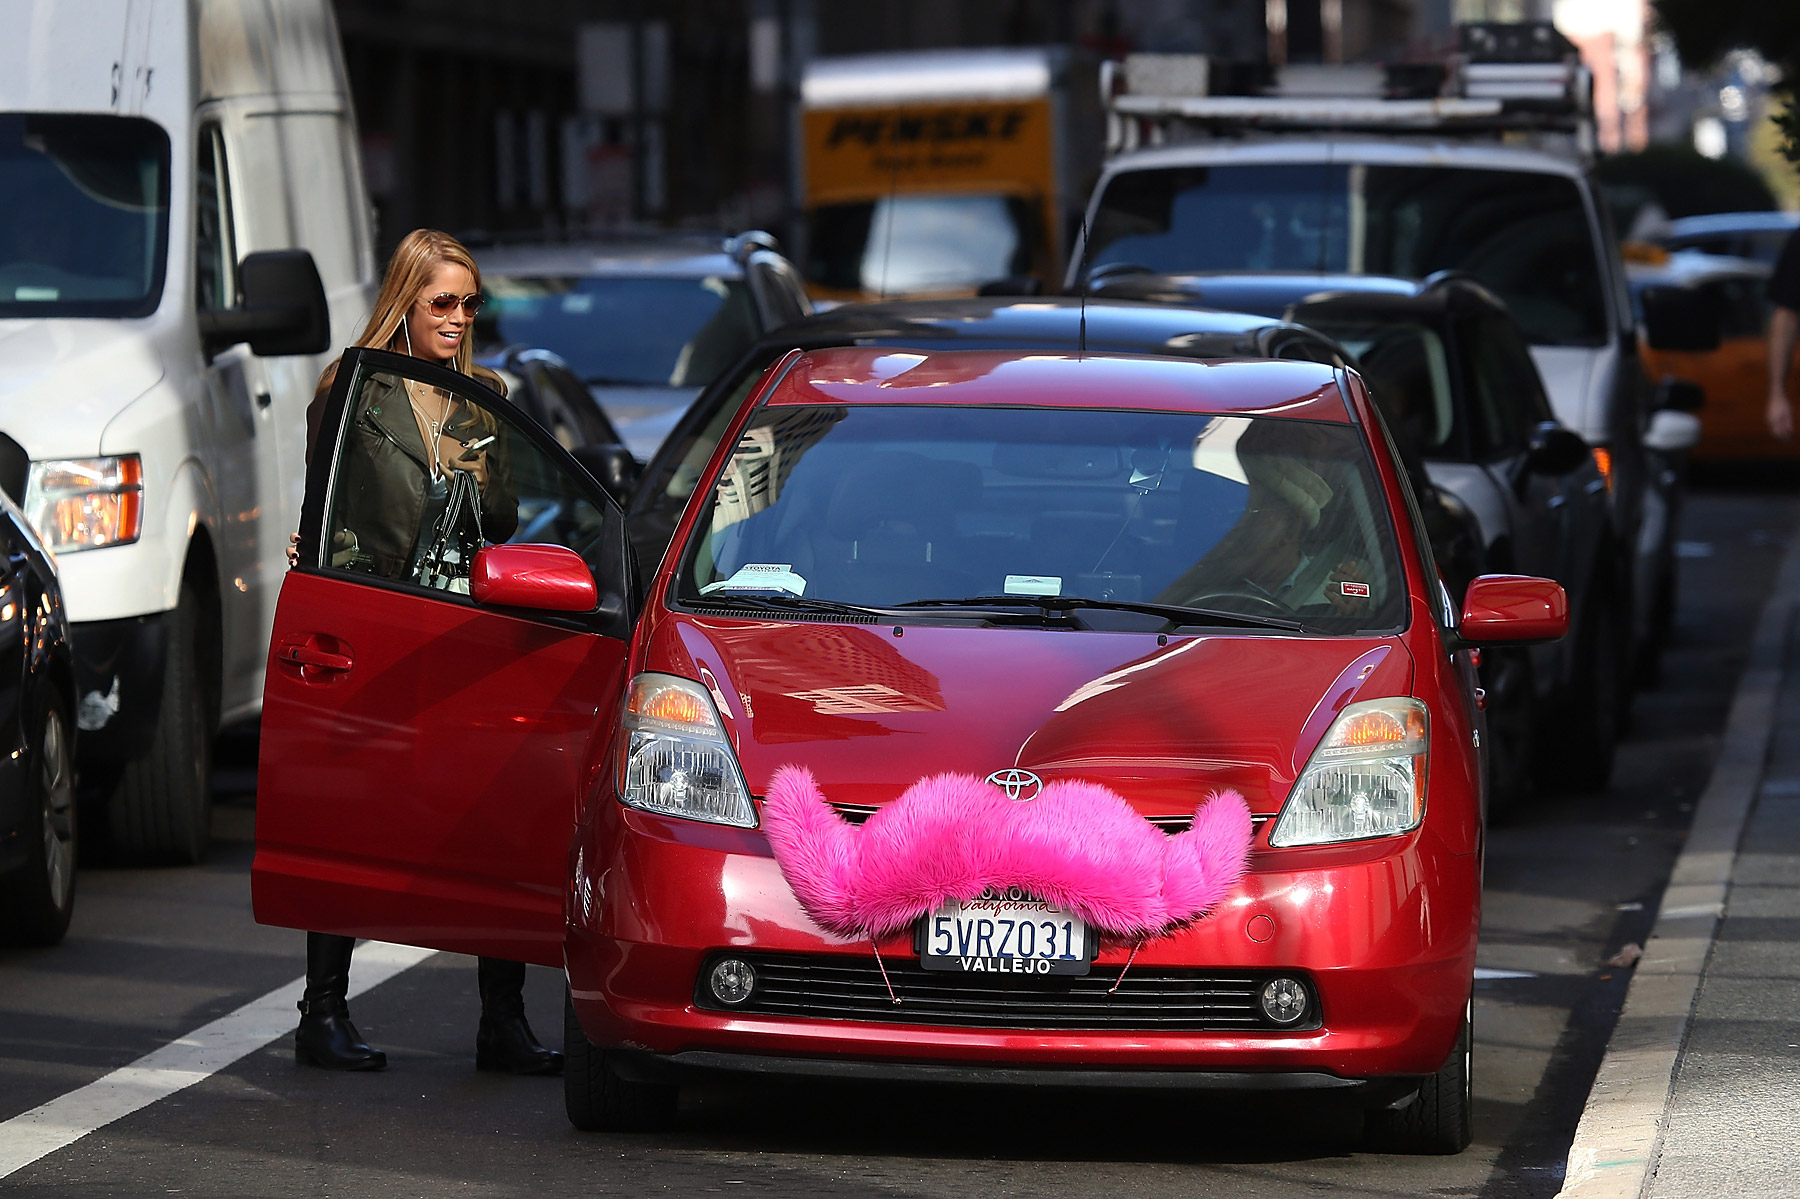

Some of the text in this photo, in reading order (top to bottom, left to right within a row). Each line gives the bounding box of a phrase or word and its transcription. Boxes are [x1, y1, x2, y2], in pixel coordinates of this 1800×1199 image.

[826, 108, 1027, 148] PENSKE
[971, 887, 1046, 901] OOT
[935, 917, 1077, 960] 5VRZ031
[960, 956, 1051, 974] VALLEJO
